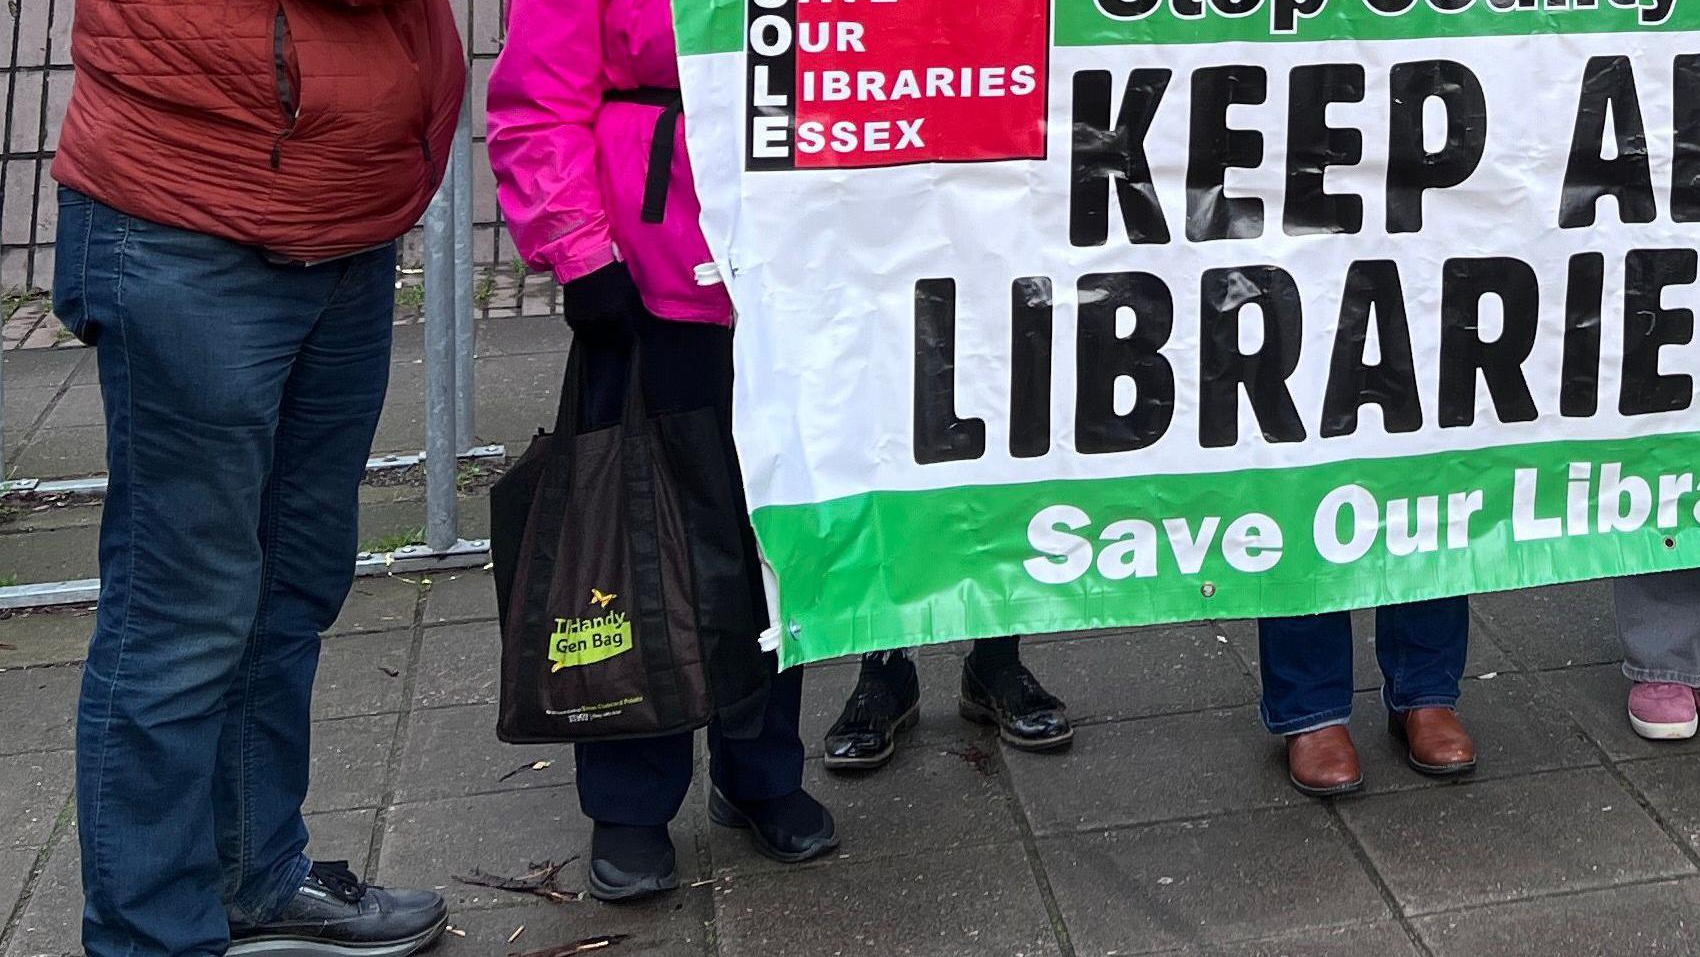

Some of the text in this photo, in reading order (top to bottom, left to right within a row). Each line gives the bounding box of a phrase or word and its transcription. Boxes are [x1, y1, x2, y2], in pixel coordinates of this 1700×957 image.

[749, 14, 866, 57] OUR
[753, 64, 1037, 107] LIBRARIES
[752, 115, 926, 159] ESSEX
[1069, 58, 1488, 247] KEEP
[1022, 504, 1285, 586] Save
[1312, 483, 1485, 565] Our
[556, 632, 623, 654] Gen Bag
